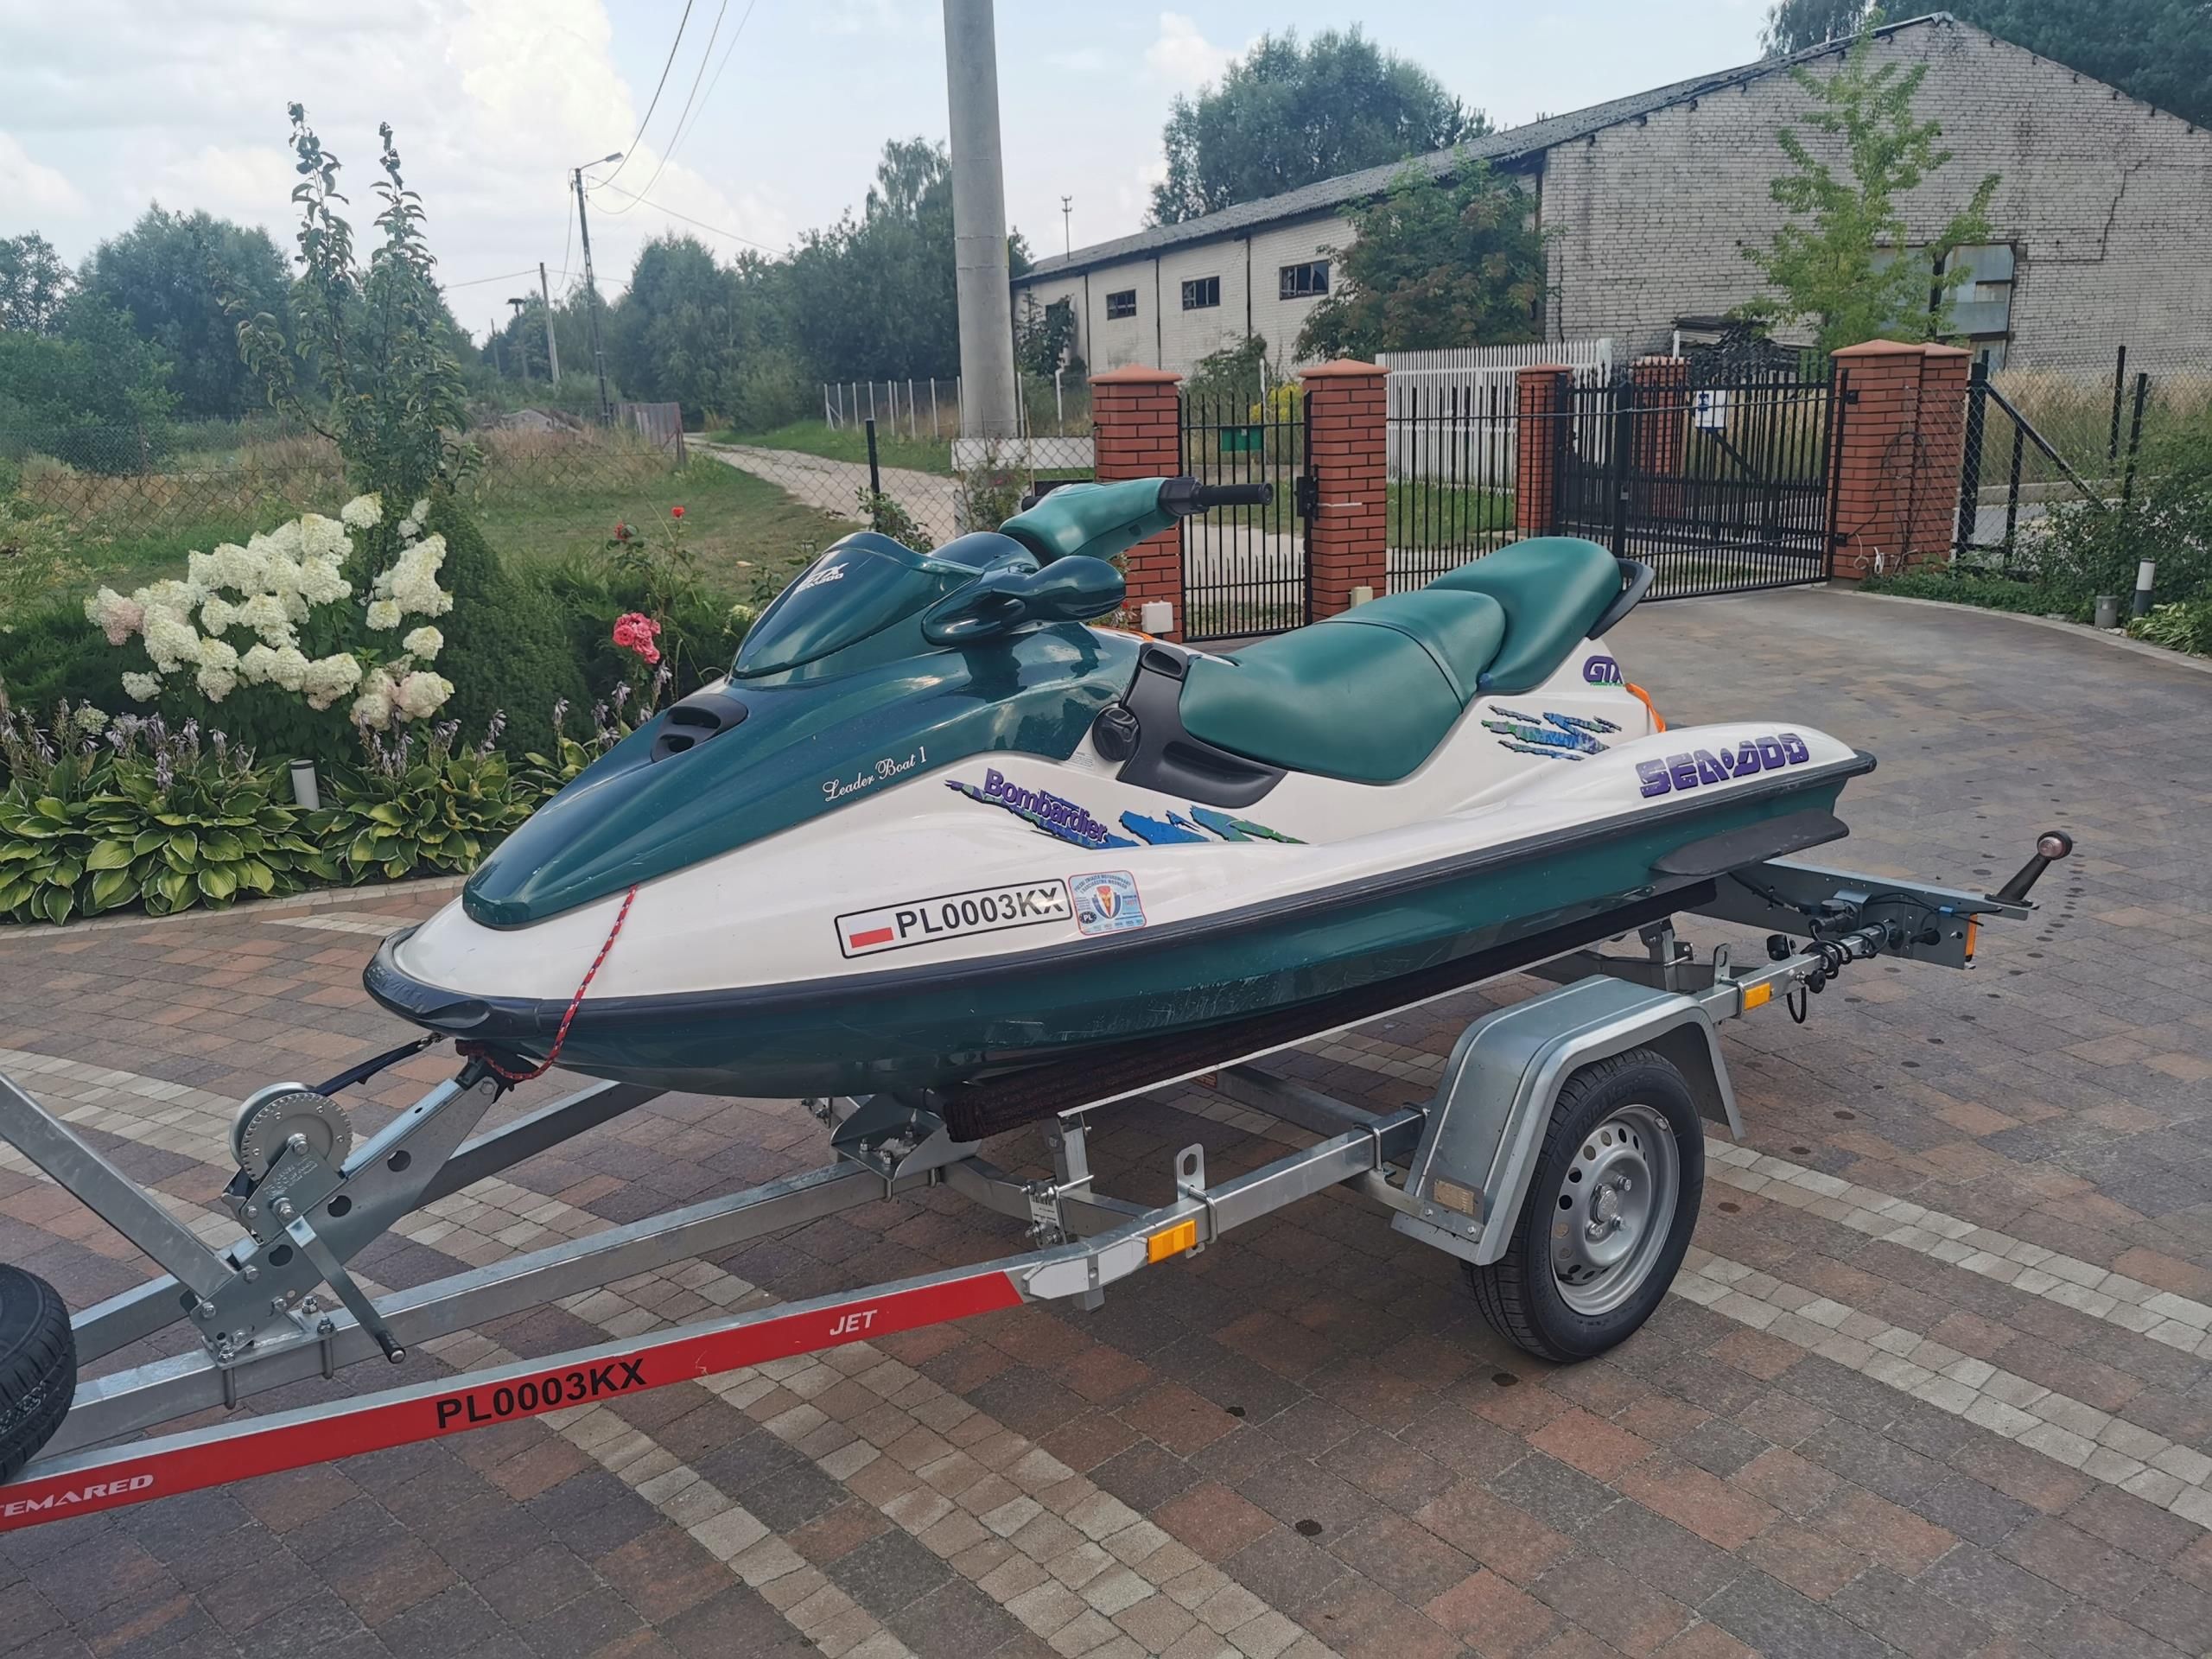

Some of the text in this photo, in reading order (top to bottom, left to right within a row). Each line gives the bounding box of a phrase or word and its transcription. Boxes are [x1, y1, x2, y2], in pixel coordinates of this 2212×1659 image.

[823, 772, 874, 802] Leader
[875, 758, 916, 779] Boat
[983, 767, 1108, 842] Bombardier
[895, 887, 1064, 938] PL0003KX
[1084, 912, 1093, 922] PL
[830, 1309, 878, 1336] JET
[436, 1357, 646, 1429] PL0003KX
[0, 1474, 154, 1517] EMARED
